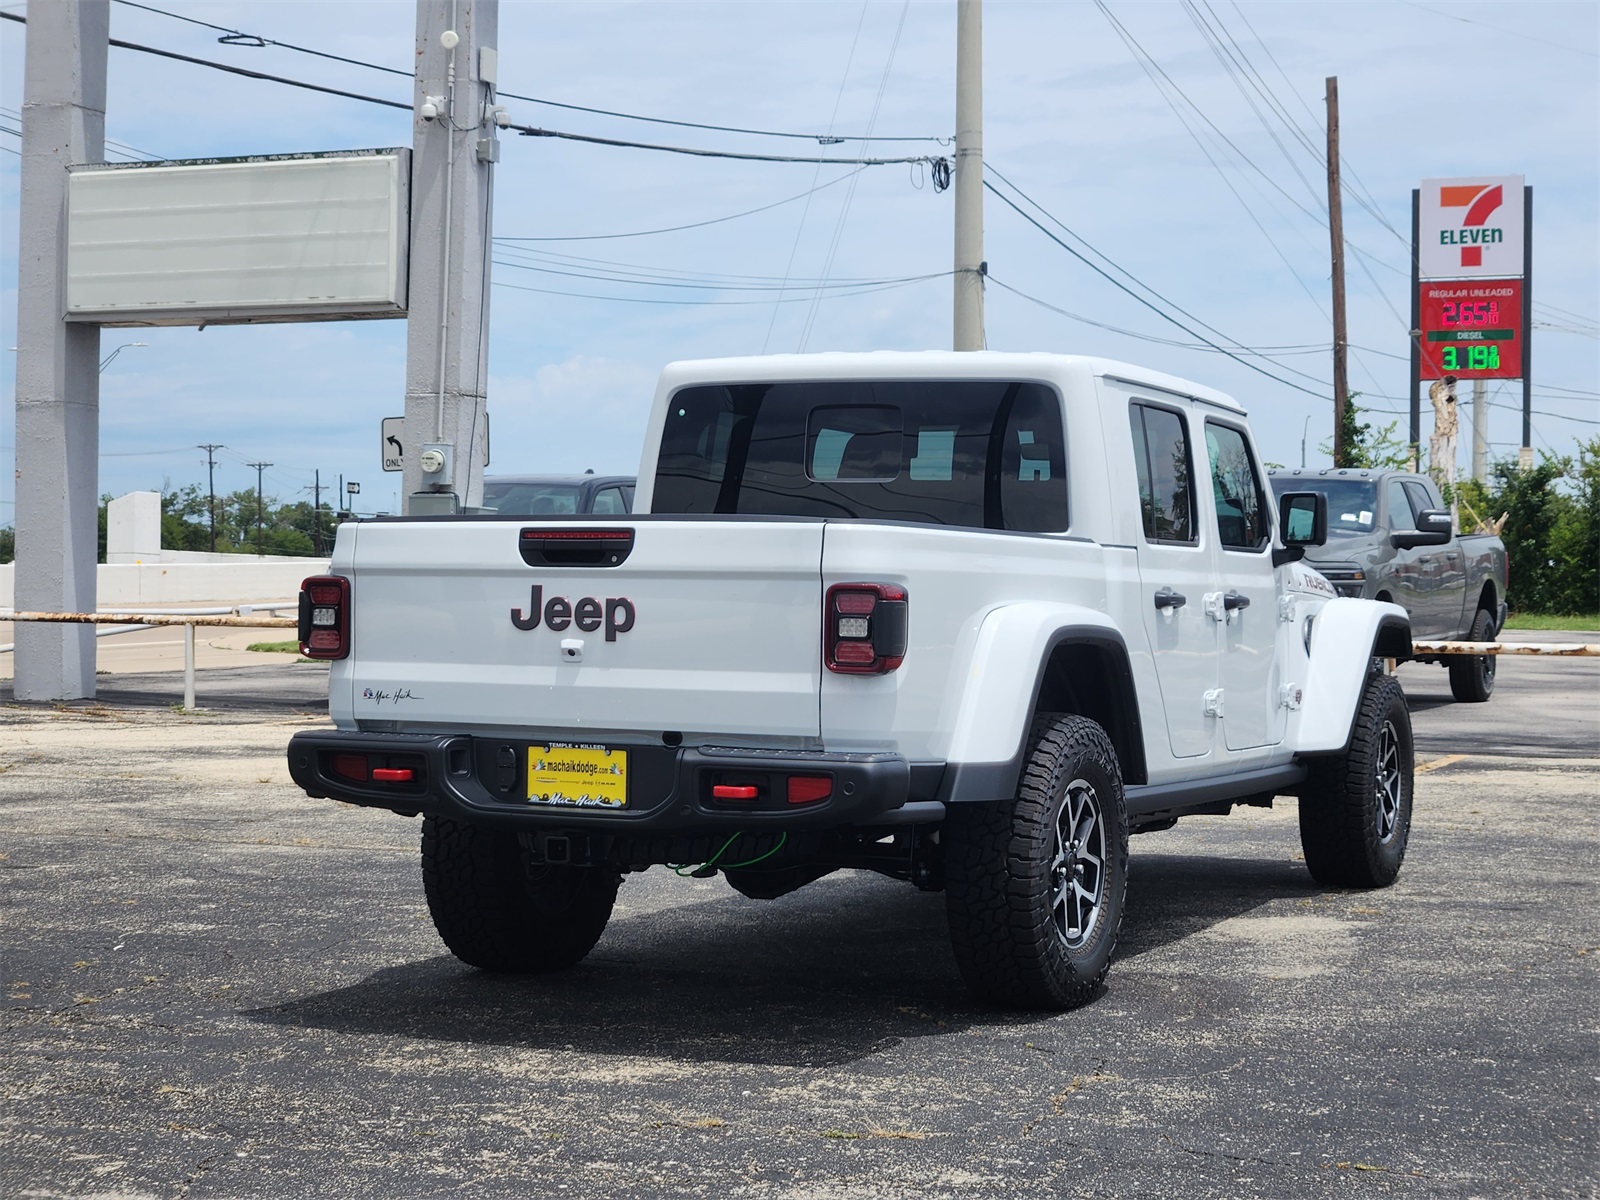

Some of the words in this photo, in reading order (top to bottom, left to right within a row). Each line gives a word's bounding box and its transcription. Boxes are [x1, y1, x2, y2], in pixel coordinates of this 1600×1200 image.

[1440, 184, 1503, 267] 7
[1429, 290, 1467, 298] REGULAR
[1470, 288, 1513, 297] UNLEADED
[1457, 331, 1484, 340] DIESEL
[510, 584, 636, 642] Jeep
[374, 690, 391, 705] Mac
[547, 760, 609, 777] machaikdodge.com
[547, 792, 574, 805] Mac
